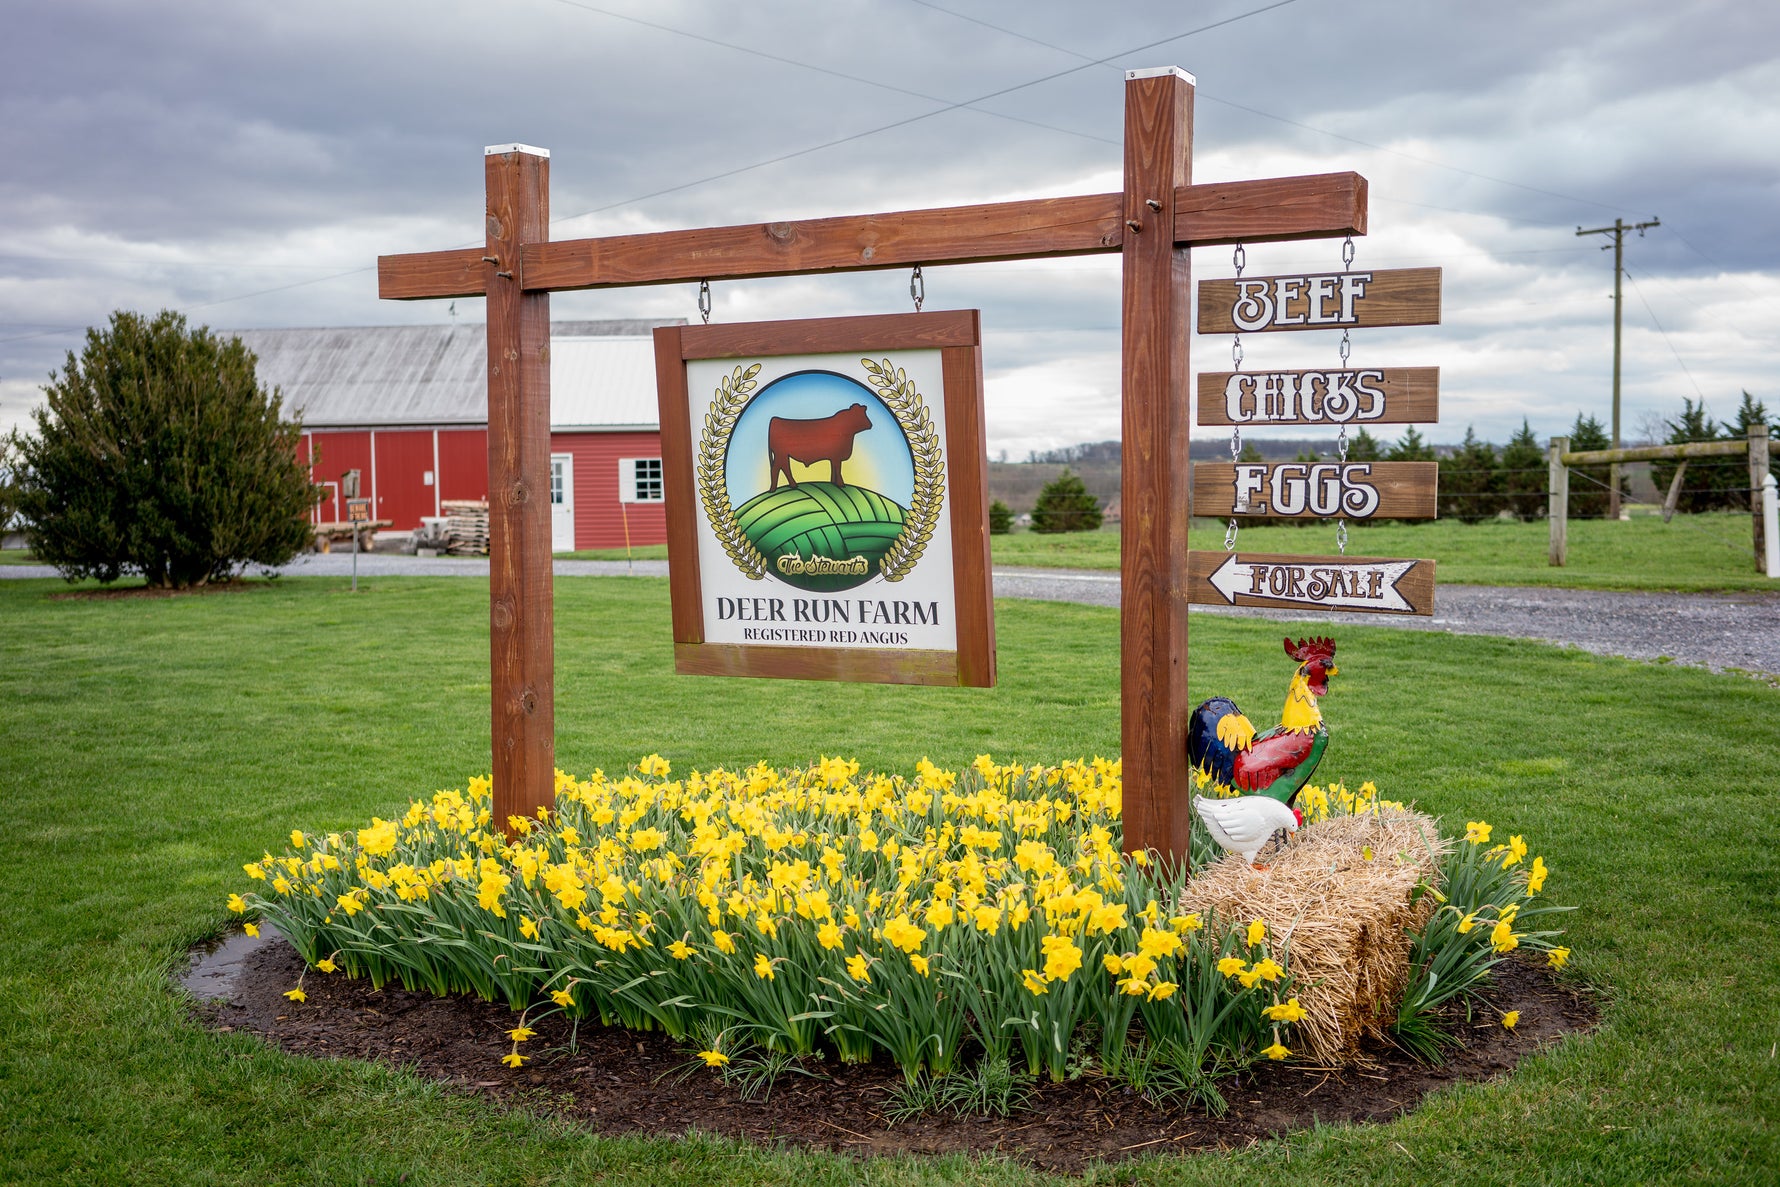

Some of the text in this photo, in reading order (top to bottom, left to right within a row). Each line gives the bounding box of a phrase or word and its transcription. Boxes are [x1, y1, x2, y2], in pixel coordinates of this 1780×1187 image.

[1232, 272, 1373, 332] BEEF
[1224, 370, 1386, 423] CHICKS
[1232, 463, 1380, 518] EGGS
[1250, 566, 1384, 600] FOR SALE
[716, 597, 940, 626] DEER RUN FARM
[743, 627, 909, 645] REGISTERED RED ANGUS
